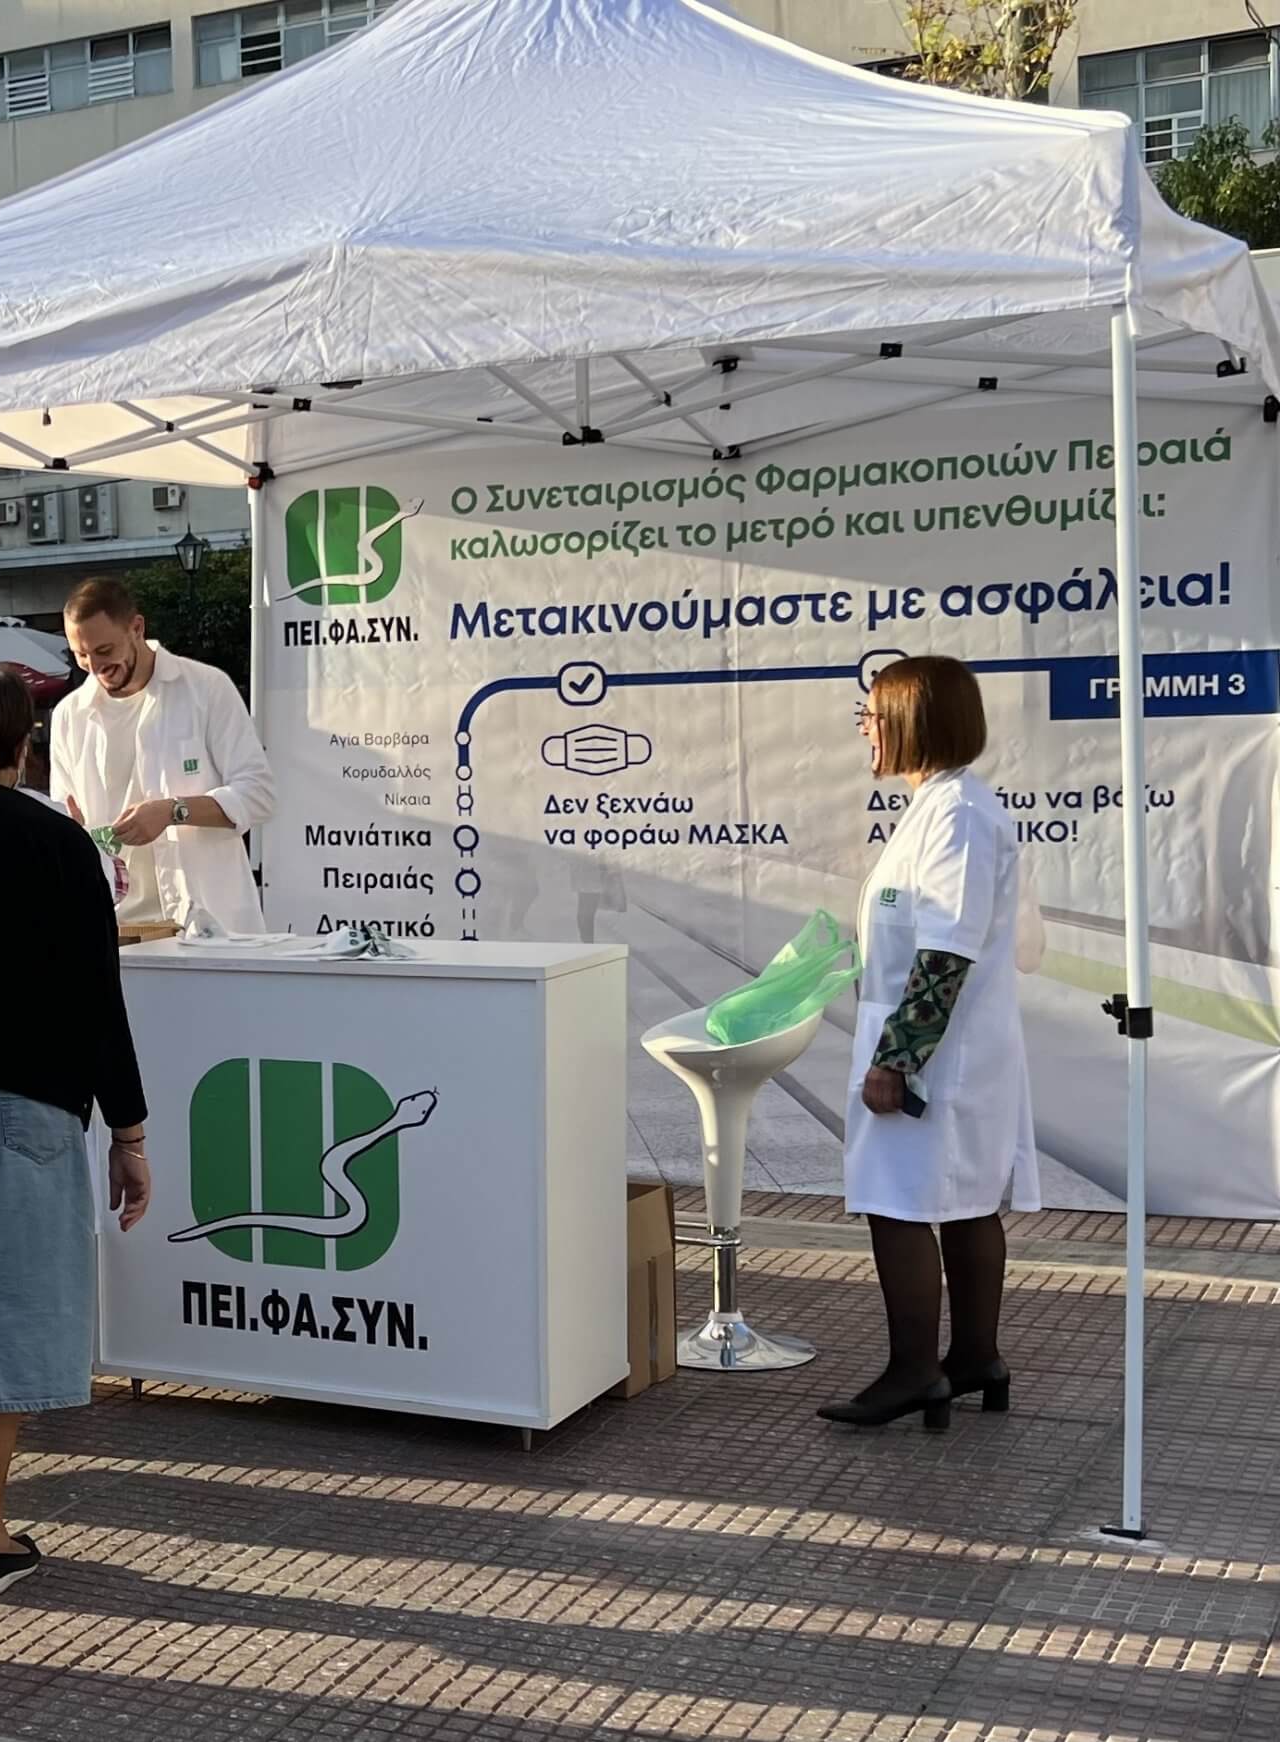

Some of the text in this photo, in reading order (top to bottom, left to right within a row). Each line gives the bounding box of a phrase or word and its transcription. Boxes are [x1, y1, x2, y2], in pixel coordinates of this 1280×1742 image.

[451, 429, 1231, 516] Ο Συνεταιρισμός Φαρμακοποιών Περαιά
[449, 488, 1166, 561] καλωσορίζει το μετρό και υπενθυμίζι:
[450, 589, 851, 639] Μετακινούμαστε
[867, 583, 926, 631] με
[283, 615, 419, 648] ΠΕΙ.ΦΑ.ΣΥΝ.
[1089, 673, 1247, 699] ΓΡΜΜΗ 3
[329, 732, 429, 748] Αγία Βαρβάρα
[342, 765, 431, 781] Κορυδαλλός
[384, 792, 431, 806] Νίκαια
[544, 790, 694, 818] Δεν ξεχνάω
[1045, 790, 1083, 809] να
[304, 823, 431, 847] Μανιάτικα
[544, 823, 788, 849] να φοράω ΜΑΣΚΑ
[323, 866, 434, 894] Πειραιάς
[181, 1279, 430, 1352] ΠΕΙ.ΦΑ.ΣΥΝ.
